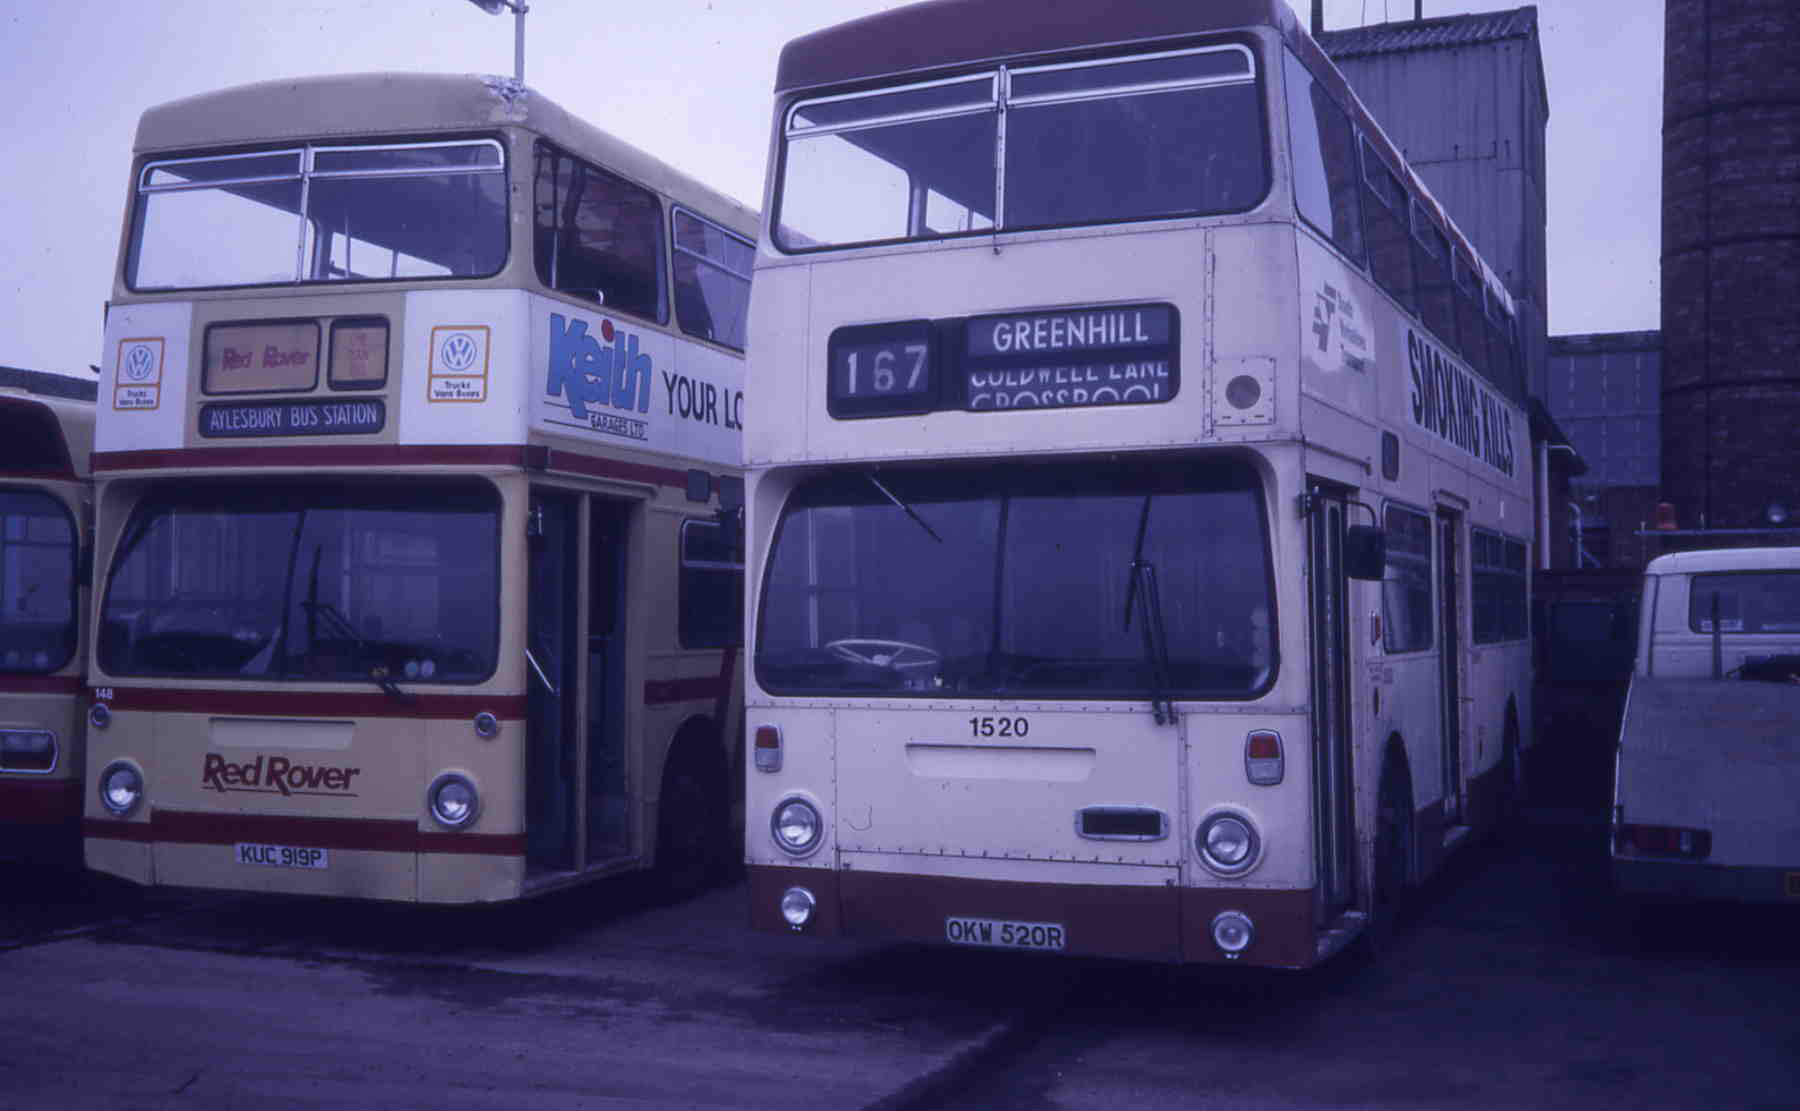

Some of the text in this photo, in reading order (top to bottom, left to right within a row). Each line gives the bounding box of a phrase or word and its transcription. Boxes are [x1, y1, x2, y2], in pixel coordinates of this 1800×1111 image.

[993, 312, 1149, 351] GREENHILL
[546, 312, 652, 419] Keith
[847, 344, 927, 395] 167
[210, 403, 377, 431] AYLESBURY BUS STATION
[662, 369, 718, 427] YOUR
[1407, 328, 1514, 478] SMOKING KILLS
[968, 717, 1029, 737] 1520
[202, 753, 360, 796] Red Rover
[240, 845, 322, 866] KUC 919P
[949, 920, 1062, 947] OKW 520R
